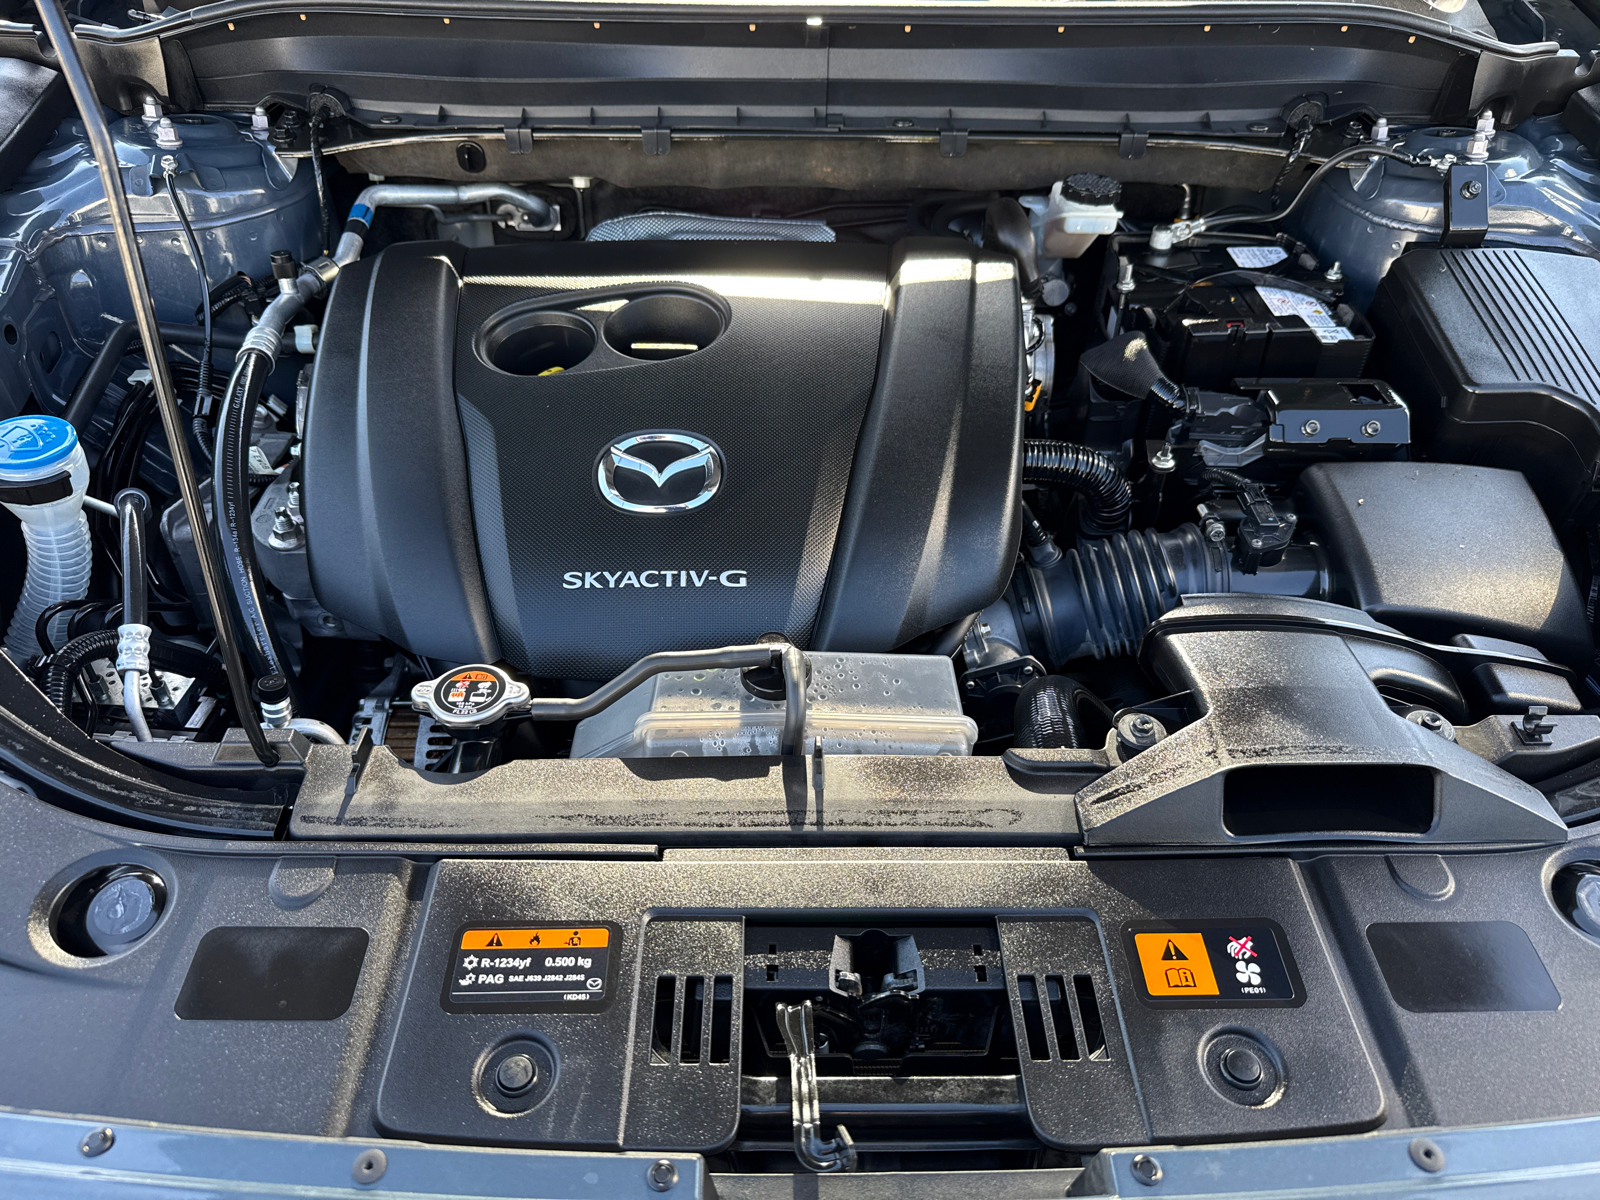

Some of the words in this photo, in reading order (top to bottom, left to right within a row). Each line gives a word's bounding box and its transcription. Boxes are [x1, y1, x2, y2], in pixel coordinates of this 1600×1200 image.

[233, 386, 244, 408] GALAXY
[236, 556, 244, 573] HOSE
[562, 570, 748, 589] SKYACTIV-G
[240, 576, 253, 605] SUCTION
[480, 957, 532, 969] R-1234yf
[544, 957, 576, 967] 0.500
[577, 956, 592, 968] kg
[478, 974, 505, 984] PAG
[542, 974, 564, 982] J2842
